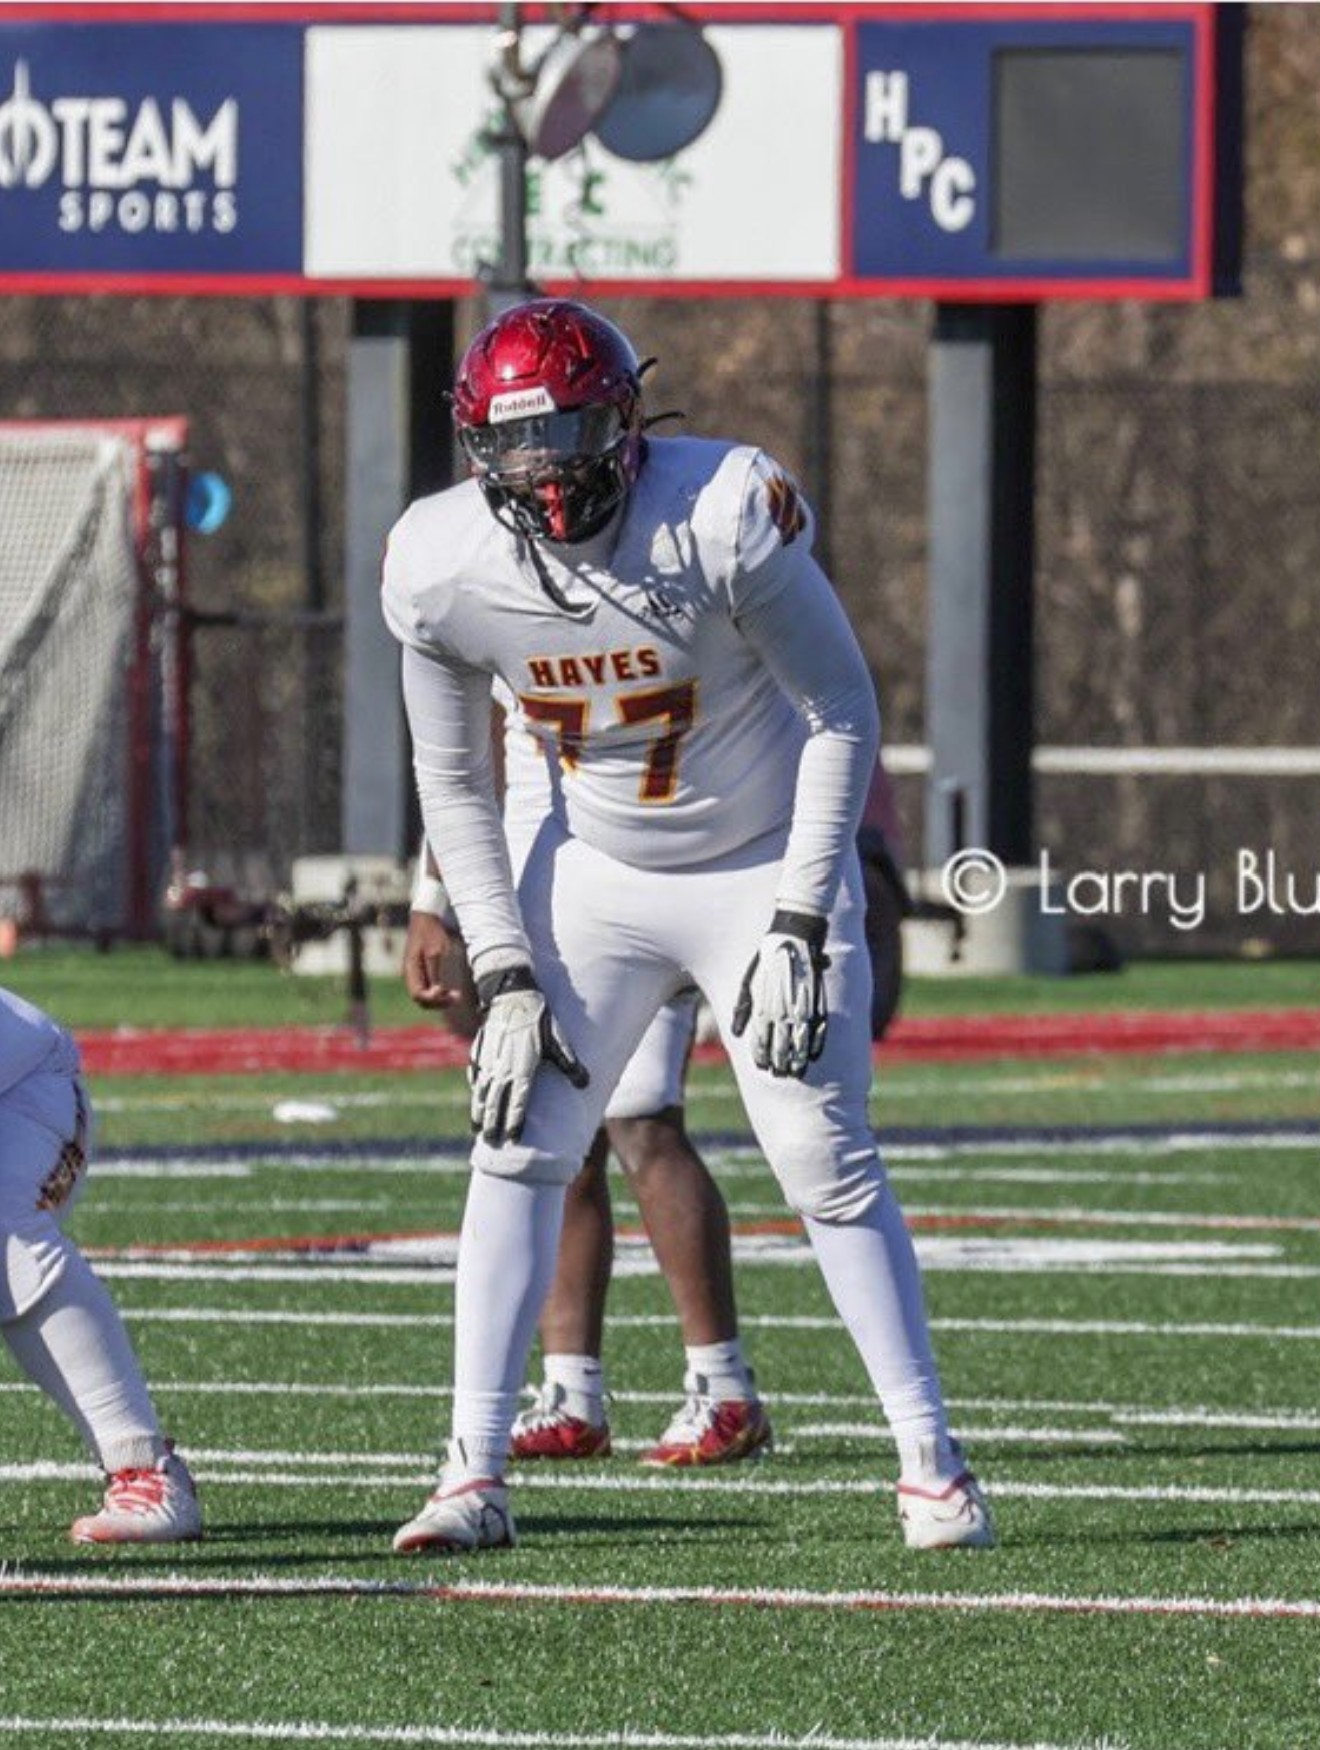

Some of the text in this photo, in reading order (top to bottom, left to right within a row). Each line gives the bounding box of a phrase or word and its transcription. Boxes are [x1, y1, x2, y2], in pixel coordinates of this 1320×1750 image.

[51, 96, 240, 189] TEAM
[57, 189, 238, 233] SPORTS
[526, 645, 664, 688] HAYES
[517, 677, 699, 805] 77
